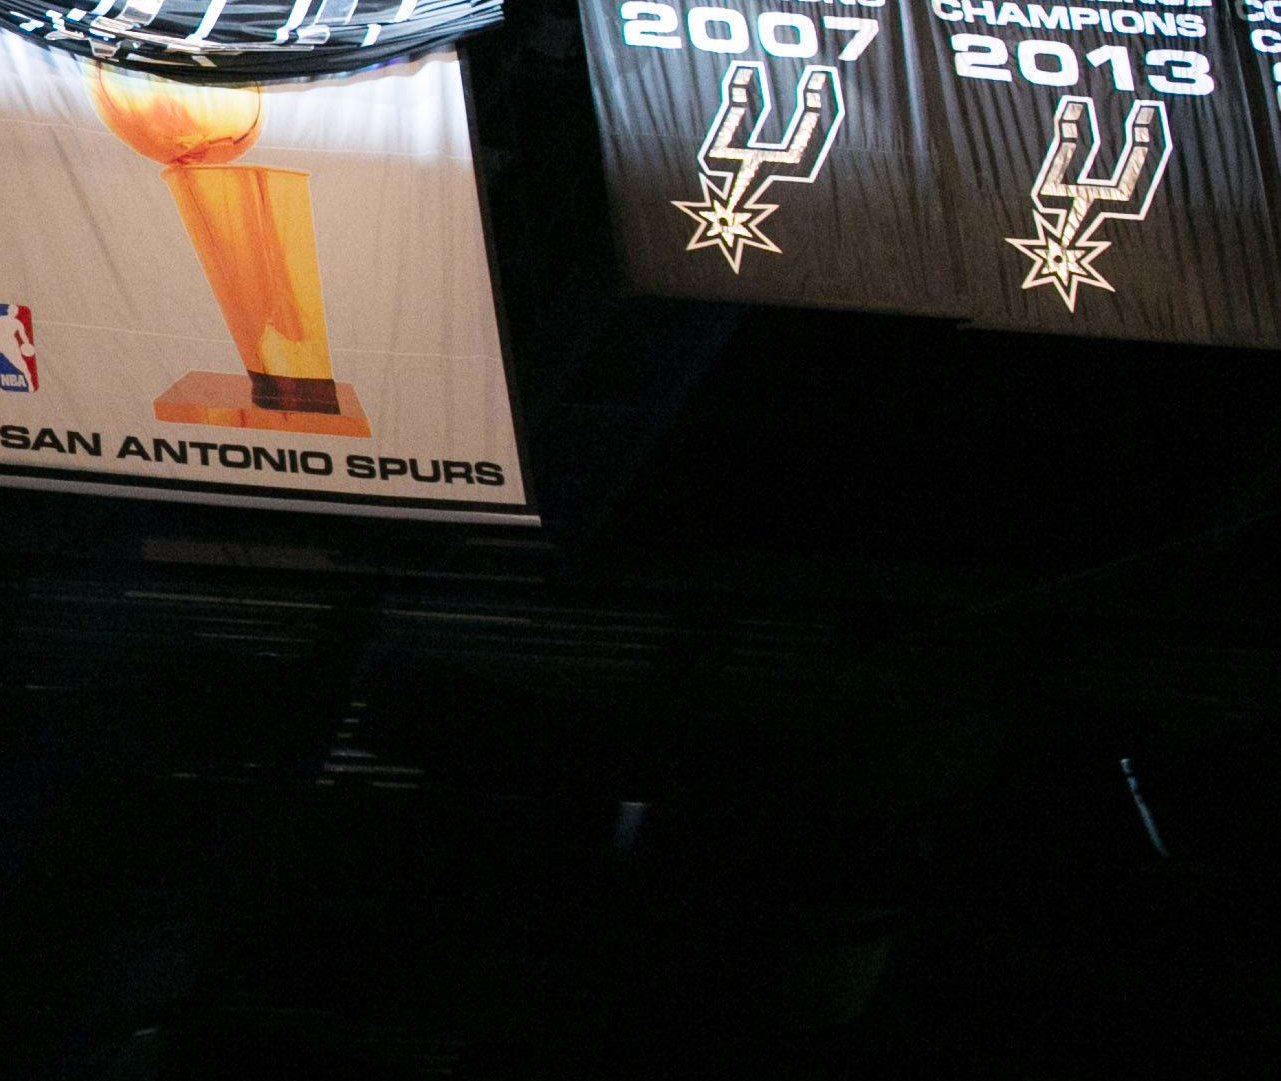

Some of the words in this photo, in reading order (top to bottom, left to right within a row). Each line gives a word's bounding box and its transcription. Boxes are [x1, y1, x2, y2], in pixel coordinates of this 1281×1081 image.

[620, 1, 879, 61] 2007
[951, 34, 1214, 96] 2013
[0, 373, 27, 389] NBA
[0, 425, 103, 458] SAN
[116, 436, 333, 476] ANTONIO
[346, 451, 504, 487] SPURS
